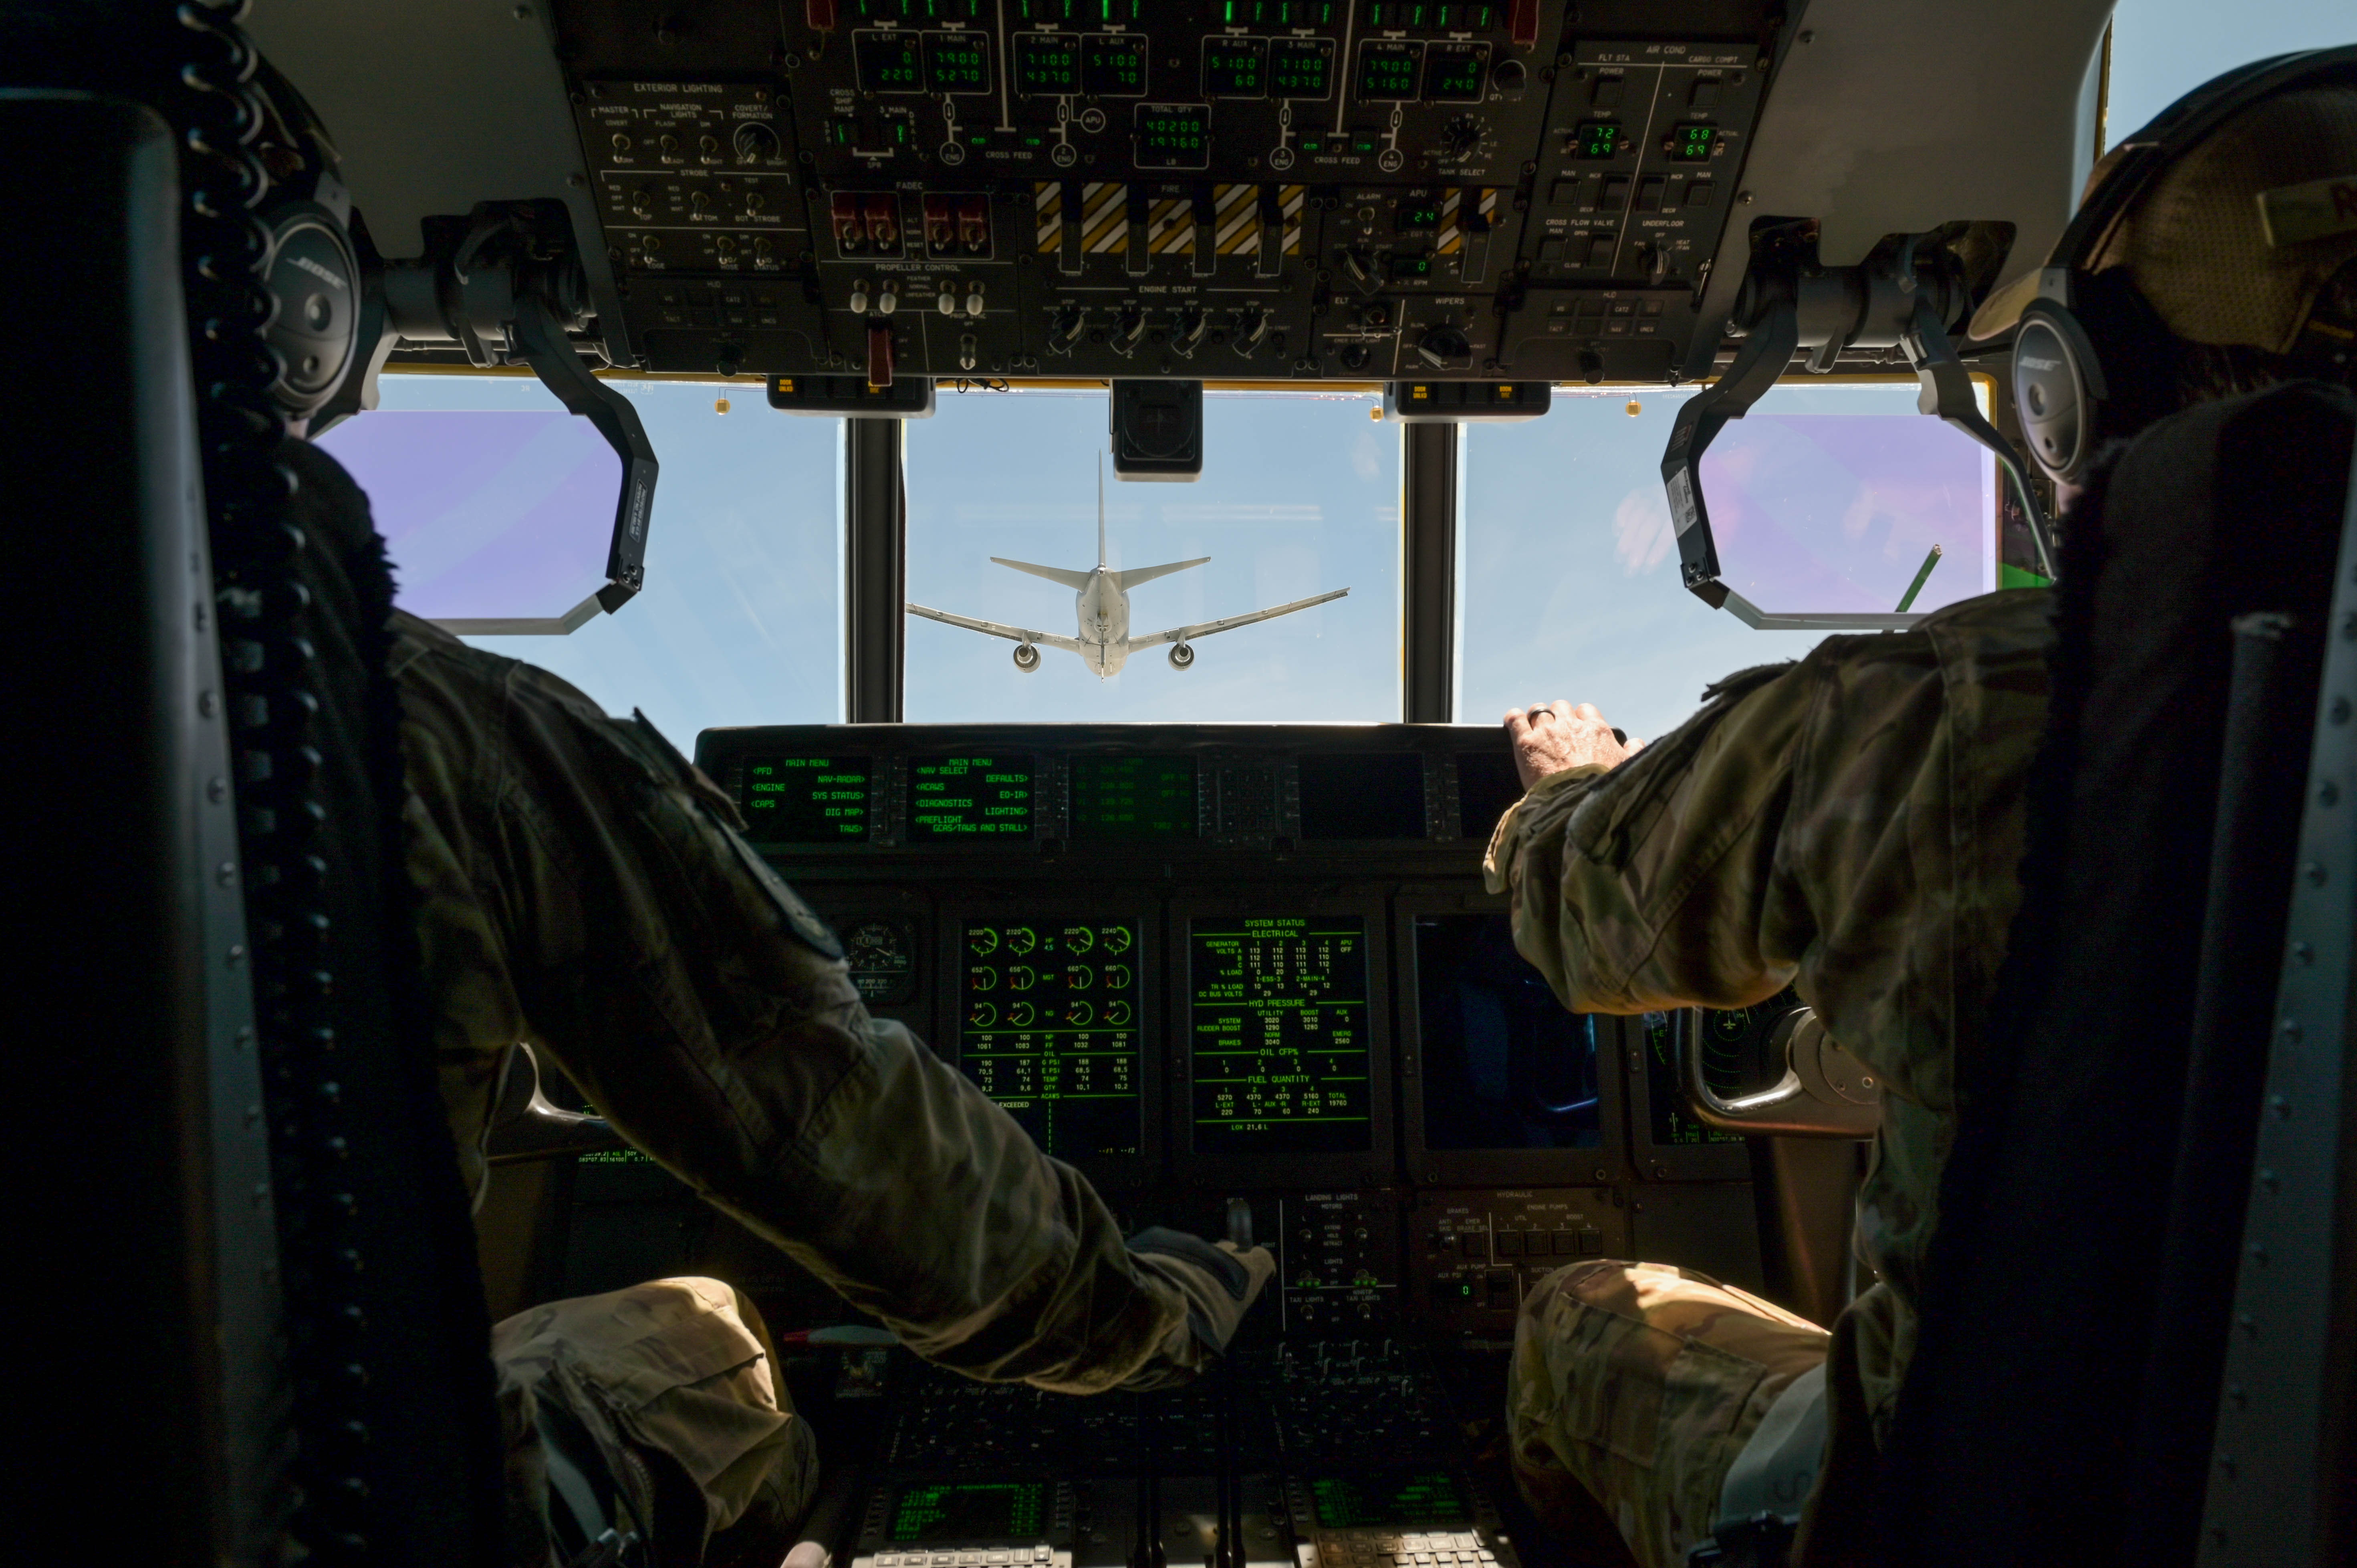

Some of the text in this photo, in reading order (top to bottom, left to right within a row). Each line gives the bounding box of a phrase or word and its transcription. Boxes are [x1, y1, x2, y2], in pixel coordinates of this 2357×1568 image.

[1028, 54, 1069, 66] 7100
[1094, 54, 1136, 66] 5100
[1213, 57, 1256, 69] 5100
[1371, 61, 1411, 72] 7900
[882, 69, 913, 81] 220
[936, 70, 979, 81] 5270
[1027, 71, 1069, 83] 4370
[1120, 72, 1136, 83] 70
[1236, 76, 1254, 86] 60
[1367, 78, 1408, 89] 5160
[1444, 79, 1473, 90] 240
[634, 84, 722, 93] EXTERIOR LIGHTING
[1147, 121, 1199, 132] 40200
[1597, 128, 1613, 138] 72
[1690, 130, 1709, 139] 68
[1149, 137, 1198, 148] 19760
[1591, 144, 1611, 154] 69
[1686, 145, 1704, 155] 69
[1162, 185, 1179, 193] FIRE
[1415, 212, 1434, 222] 24
